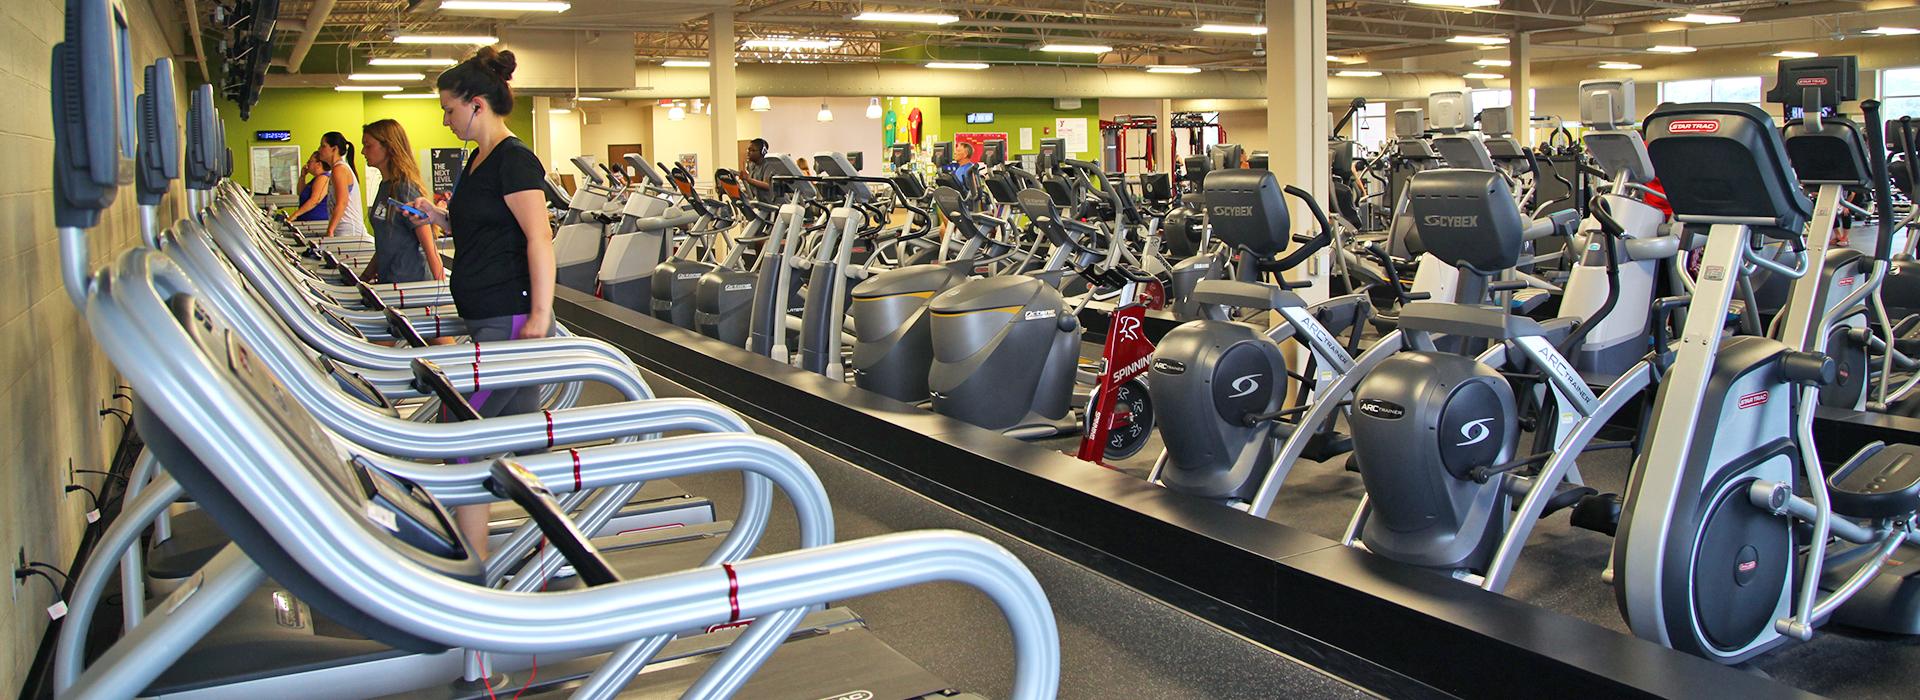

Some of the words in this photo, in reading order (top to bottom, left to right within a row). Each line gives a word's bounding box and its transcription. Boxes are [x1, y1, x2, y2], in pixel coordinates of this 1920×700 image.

[1440, 215, 1478, 227] CYBEX
[1025, 309, 1056, 318] Octane
[1301, 317, 1326, 341] ARC
[1324, 338, 1346, 363] TRAINER
[1154, 362, 1168, 370] ARC
[1538, 347, 1567, 376] ARC
[1565, 372, 1591, 403] TRAINER
[1361, 403, 1379, 412] ARC
[1379, 407, 1402, 415] TRAINER
